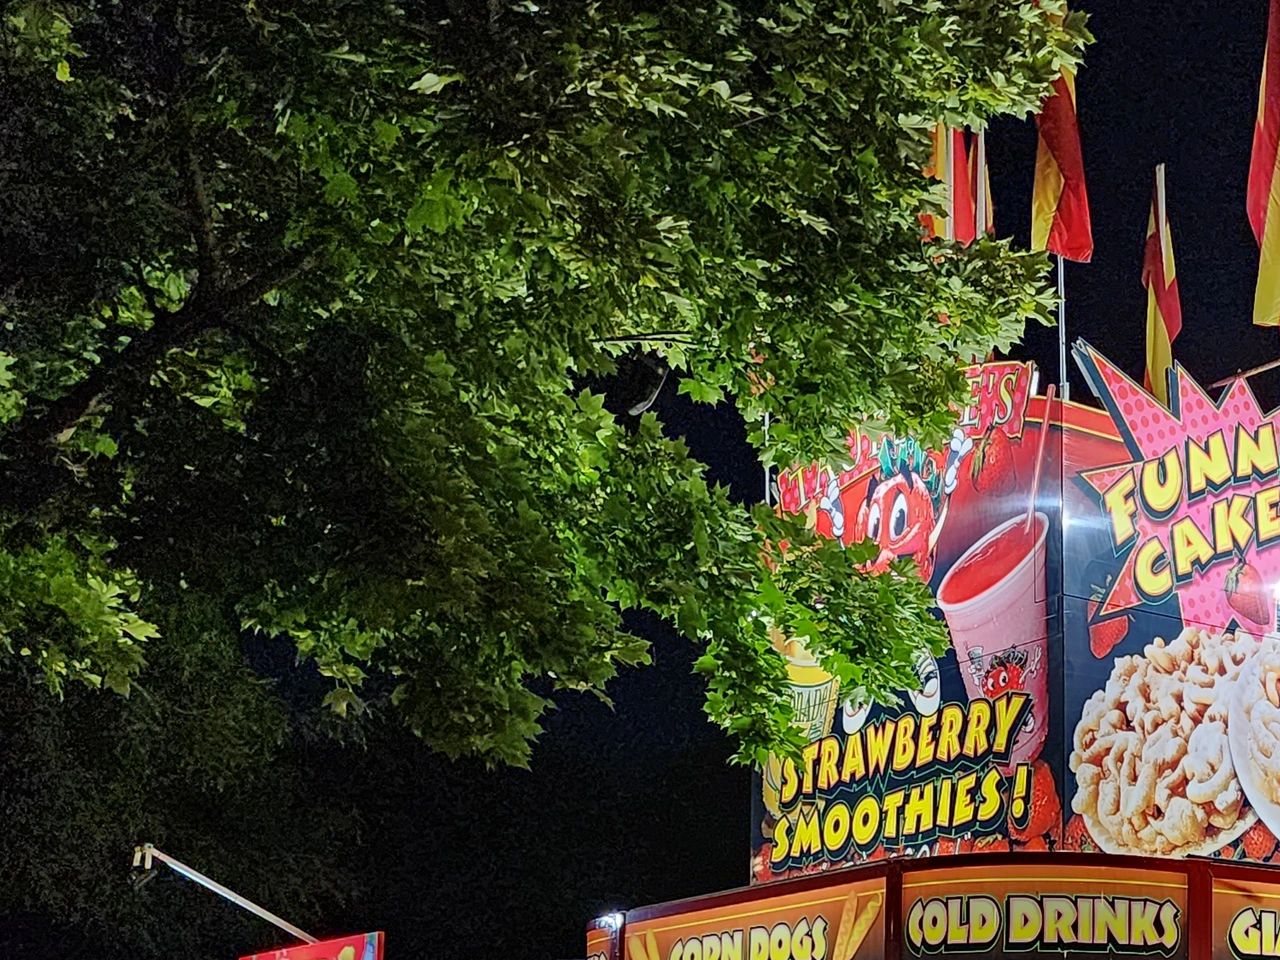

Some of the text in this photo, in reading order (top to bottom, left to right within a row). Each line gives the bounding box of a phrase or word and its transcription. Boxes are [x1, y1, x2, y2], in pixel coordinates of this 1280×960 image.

[780, 694, 1030, 802] STRAWBERRY
[769, 766, 1029, 863] SMOOTHIES!
[906, 895, 1180, 949] COLD DRINKS
